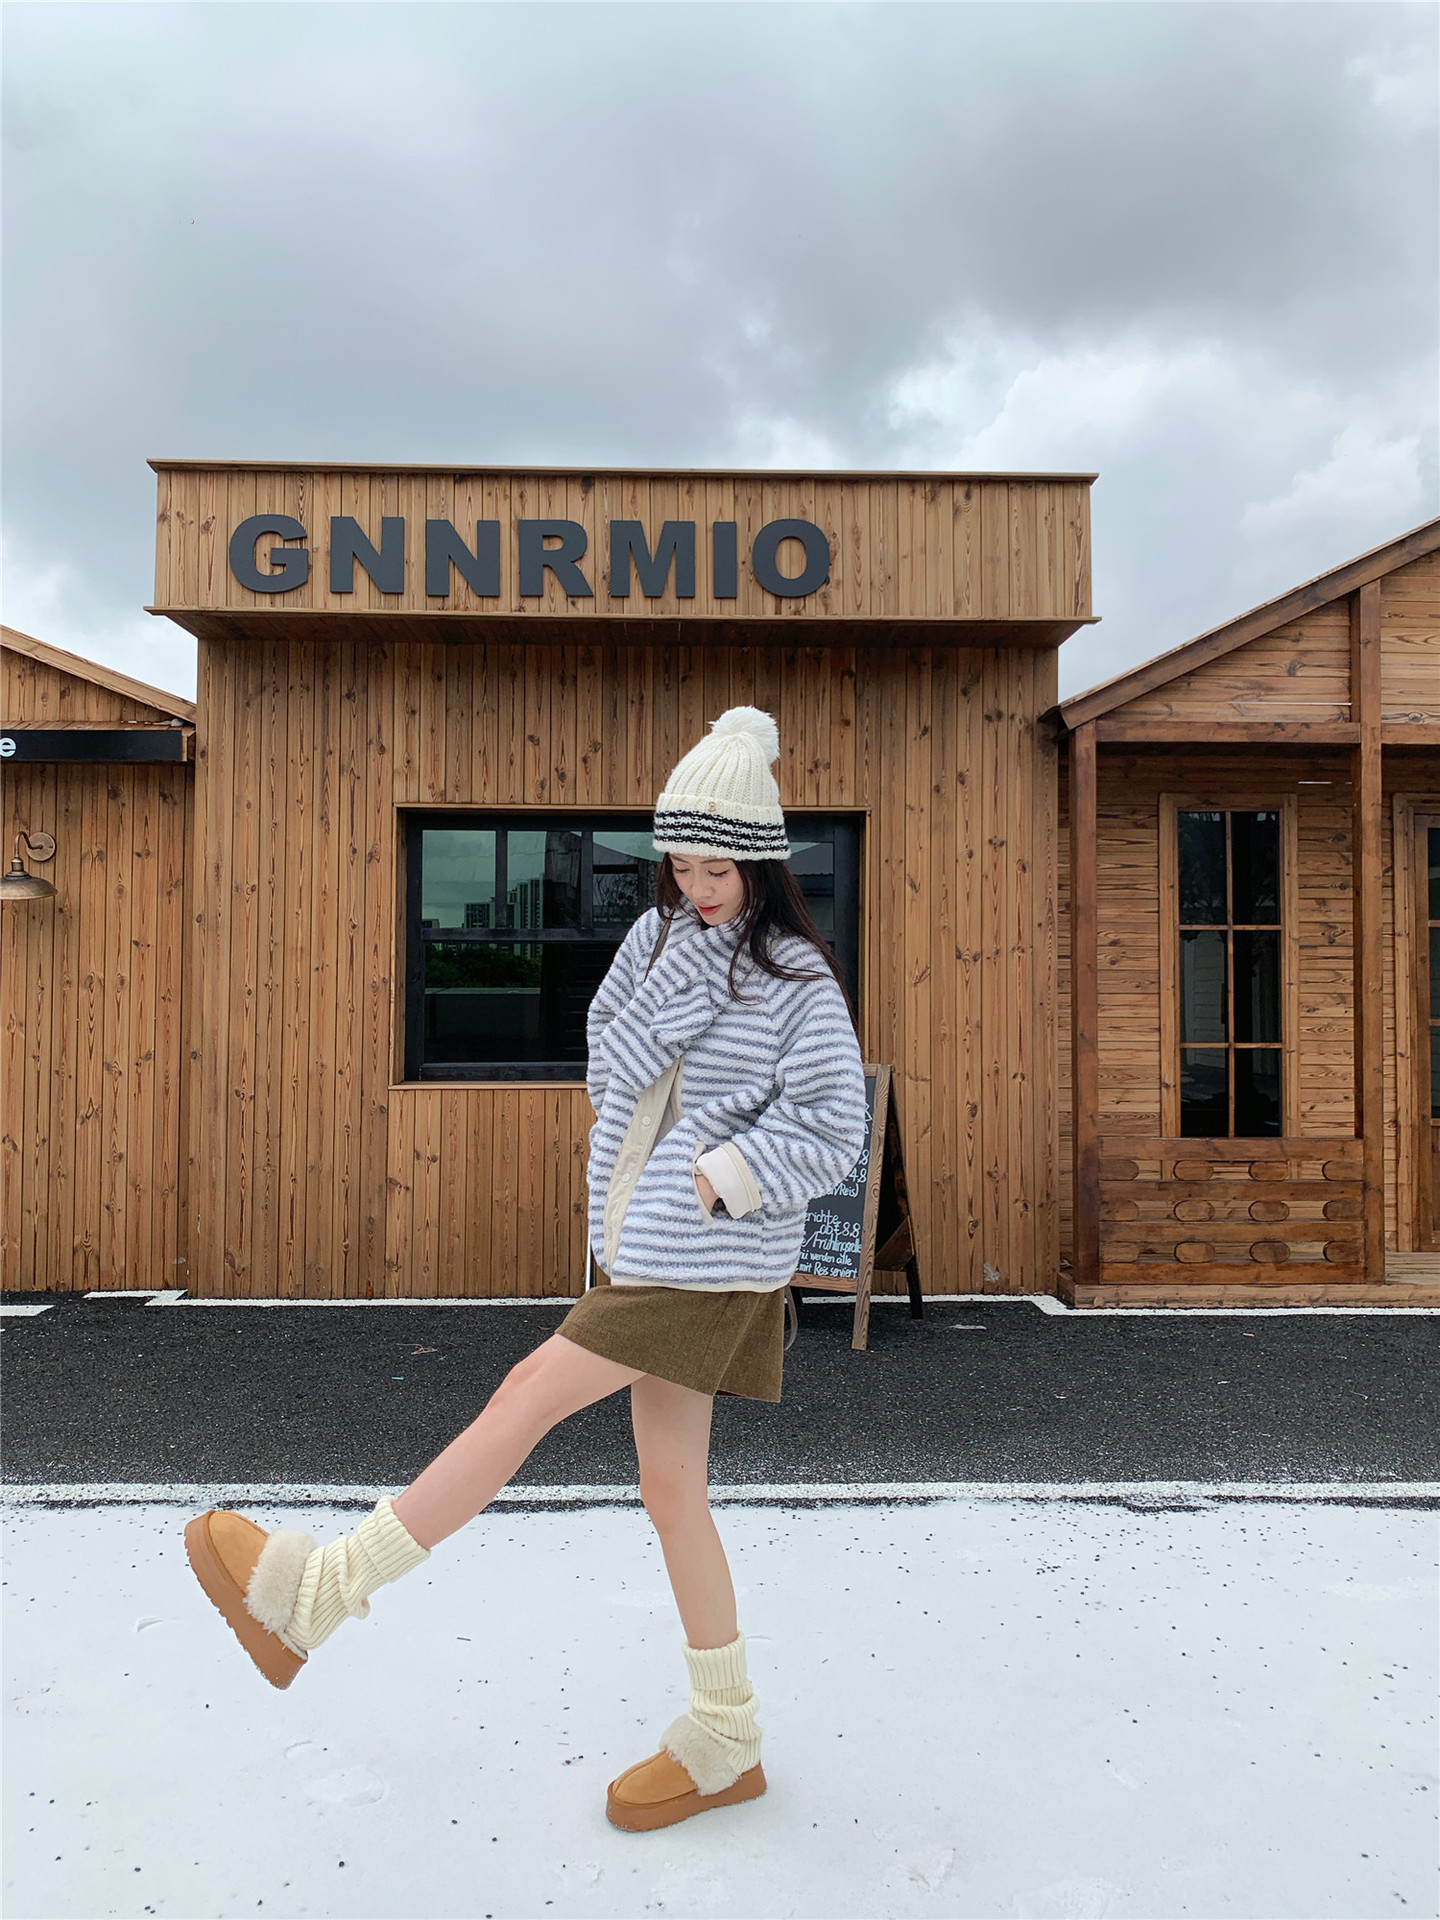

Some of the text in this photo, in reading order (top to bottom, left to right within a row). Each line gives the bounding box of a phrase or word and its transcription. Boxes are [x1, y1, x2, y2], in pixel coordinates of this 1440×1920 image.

[229, 513, 830, 599] GNNRMIO
[813, 1261, 829, 1276] Reis
[830, 1267, 858, 1279] serviert
